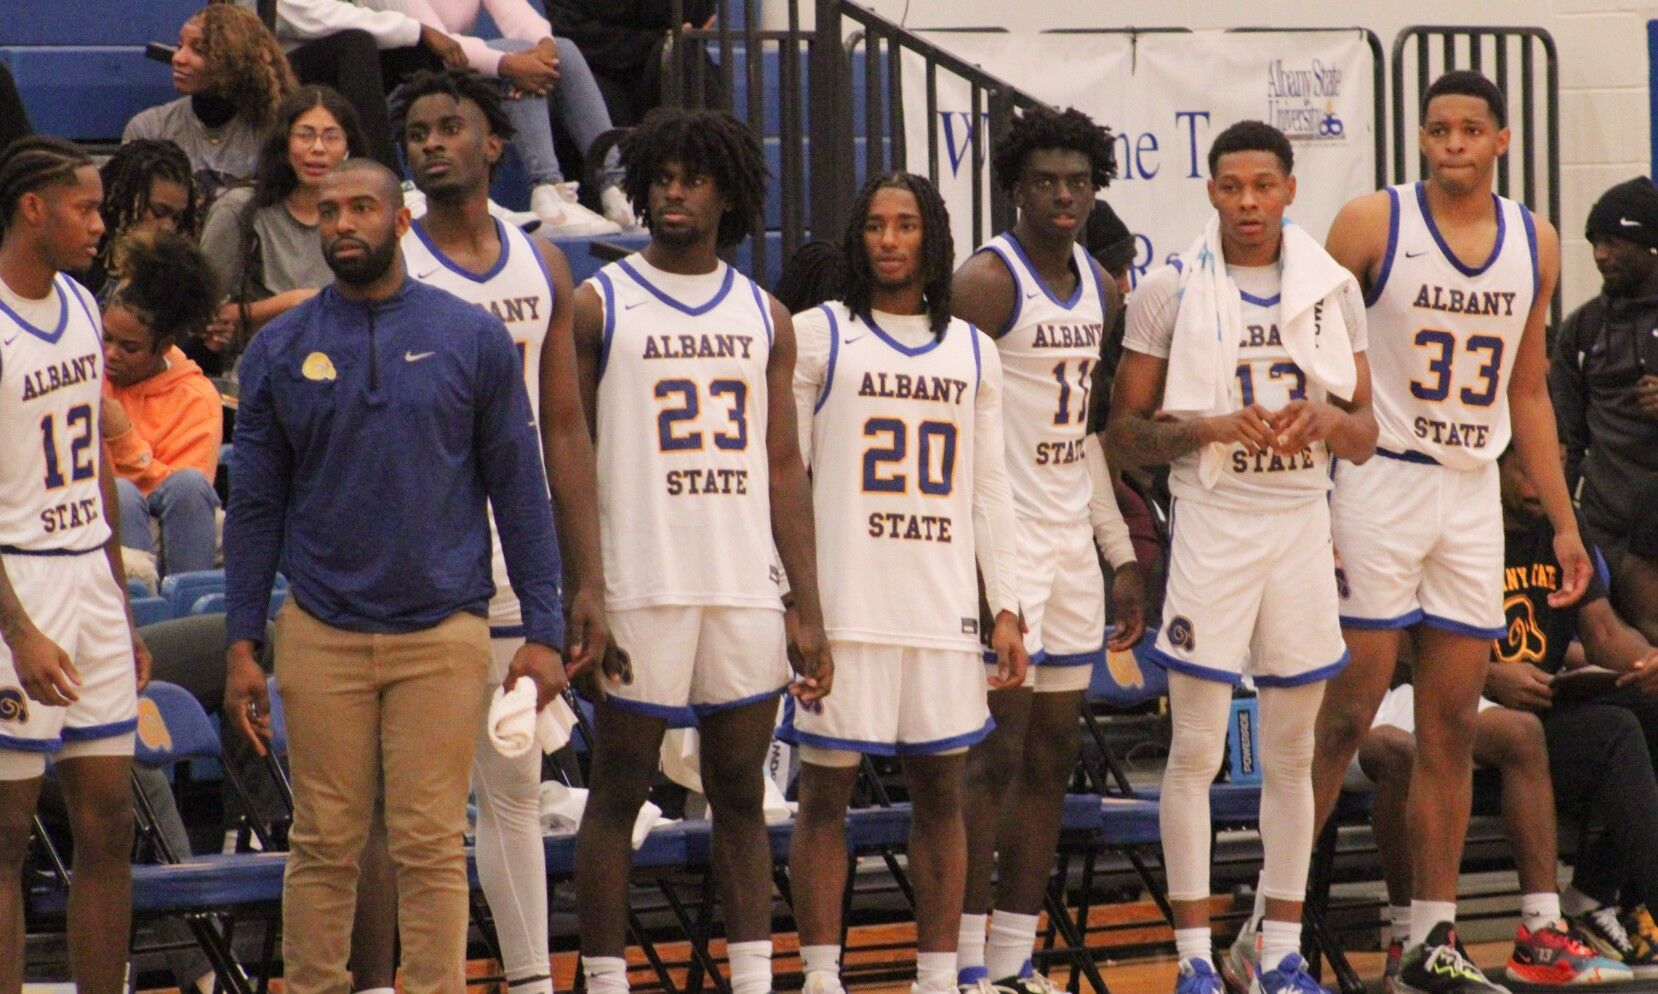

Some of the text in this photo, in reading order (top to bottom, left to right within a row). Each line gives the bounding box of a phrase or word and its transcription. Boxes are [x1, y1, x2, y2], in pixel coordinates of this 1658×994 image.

[1268, 59, 1311, 98] Albany
[1175, 111, 1210, 179] T
[1413, 284, 1516, 316] ALBANY
[643, 334, 753, 360] ALBANY
[1410, 329, 1504, 407] 33
[22, 354, 97, 401] ALBANY
[858, 372, 967, 405] ALBANY
[654, 378, 749, 453] 23
[1414, 416, 1489, 448] STATE
[40, 404, 96, 490] 12
[862, 415, 958, 497] 20
[666, 469, 748, 496] STATE
[868, 512, 953, 543] STATE
[1239, 712, 1253, 773] POWERADE
